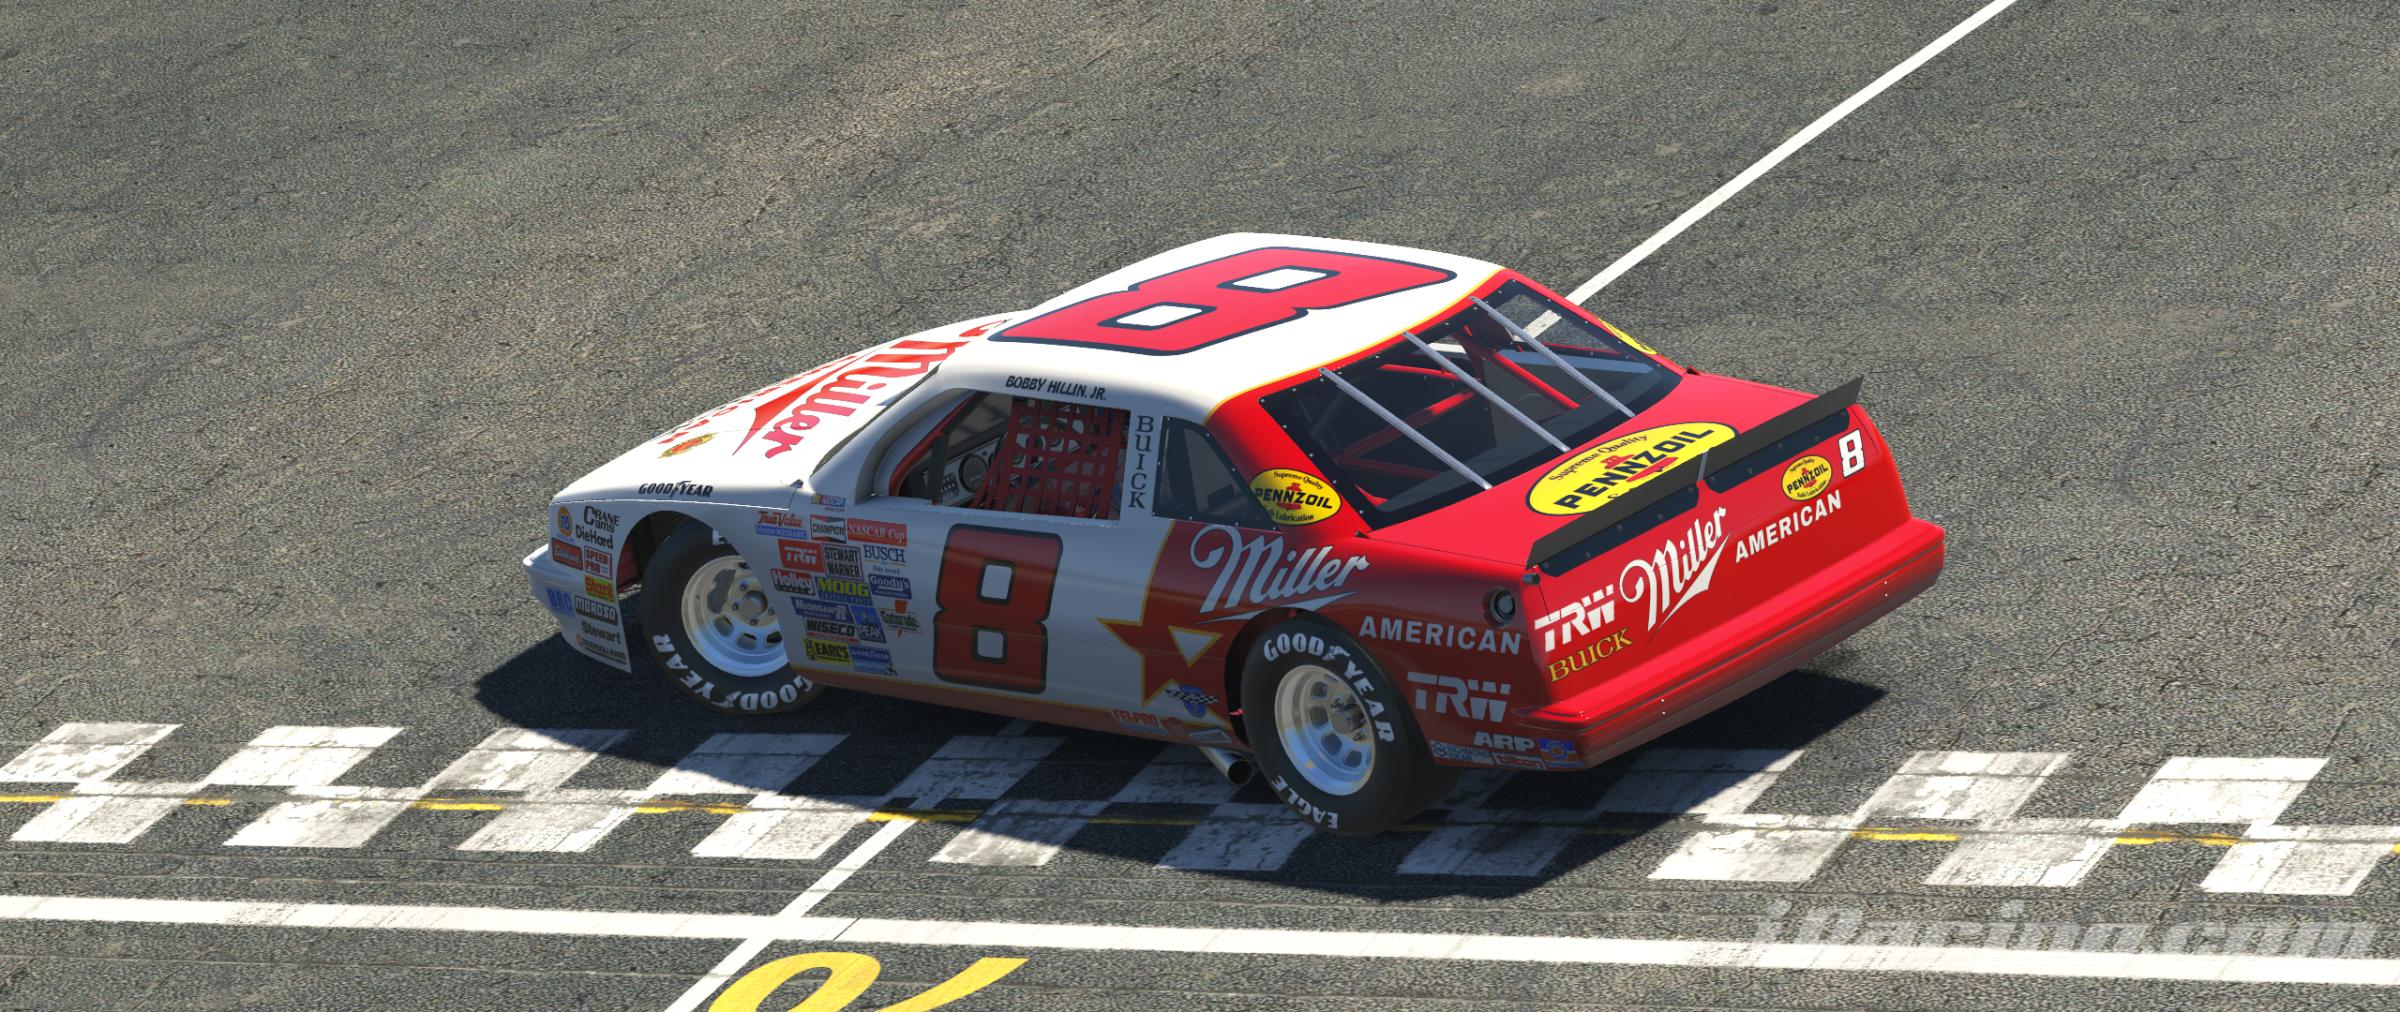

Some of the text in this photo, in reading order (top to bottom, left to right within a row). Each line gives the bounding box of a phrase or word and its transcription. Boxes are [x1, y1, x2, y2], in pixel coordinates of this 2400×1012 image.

[988, 245, 1458, 356] 8
[764, 318, 1008, 459] Miller
[1005, 375, 1047, 391] BOBBY
[1090, 386, 1106, 400] JR.
[1127, 415, 1154, 509] BUICK
[1549, 434, 1648, 481] Supreme Quality
[1838, 429, 1865, 479] 8
[1273, 471, 1323, 490] Supreme Quality
[1553, 429, 1715, 509] PENNZOIL
[1787, 464, 1828, 494] PENNZOIL
[638, 481, 713, 498] GOODYEAR
[1254, 487, 1333, 509] PENNZOIL
[584, 505, 620, 526] CRANE
[1276, 510, 1314, 522] Lubrication
[1735, 490, 1842, 564] AMERICAN
[576, 524, 613, 549] DieHard
[812, 523, 846, 536] CHAMPION
[849, 524, 904, 543] NASCAR Cup
[784, 546, 818, 565] TRW
[824, 546, 858, 564] STEWART
[863, 544, 905, 562] BUSCH
[1190, 525, 1369, 613] Miller
[1619, 506, 1727, 632] Miller
[772, 570, 814, 594] Holley
[816, 579, 870, 598] MOOG
[870, 575, 910, 592] Goody's
[933, 524, 1063, 694] 8
[1534, 584, 1614, 652] TRW
[581, 620, 621, 644] Stewart
[806, 619, 855, 636] WISECO
[858, 624, 884, 642] PEAK
[1359, 615, 1521, 655] AMERICAN
[1546, 628, 1633, 683] BUICK
[653, 634, 814, 711] GOODYEAR
[1264, 633, 1395, 742] GOODYEAR
[1407, 671, 1511, 723] TRW
[1473, 731, 1535, 751] ARP
[1272, 775, 1338, 829] EAGLE
